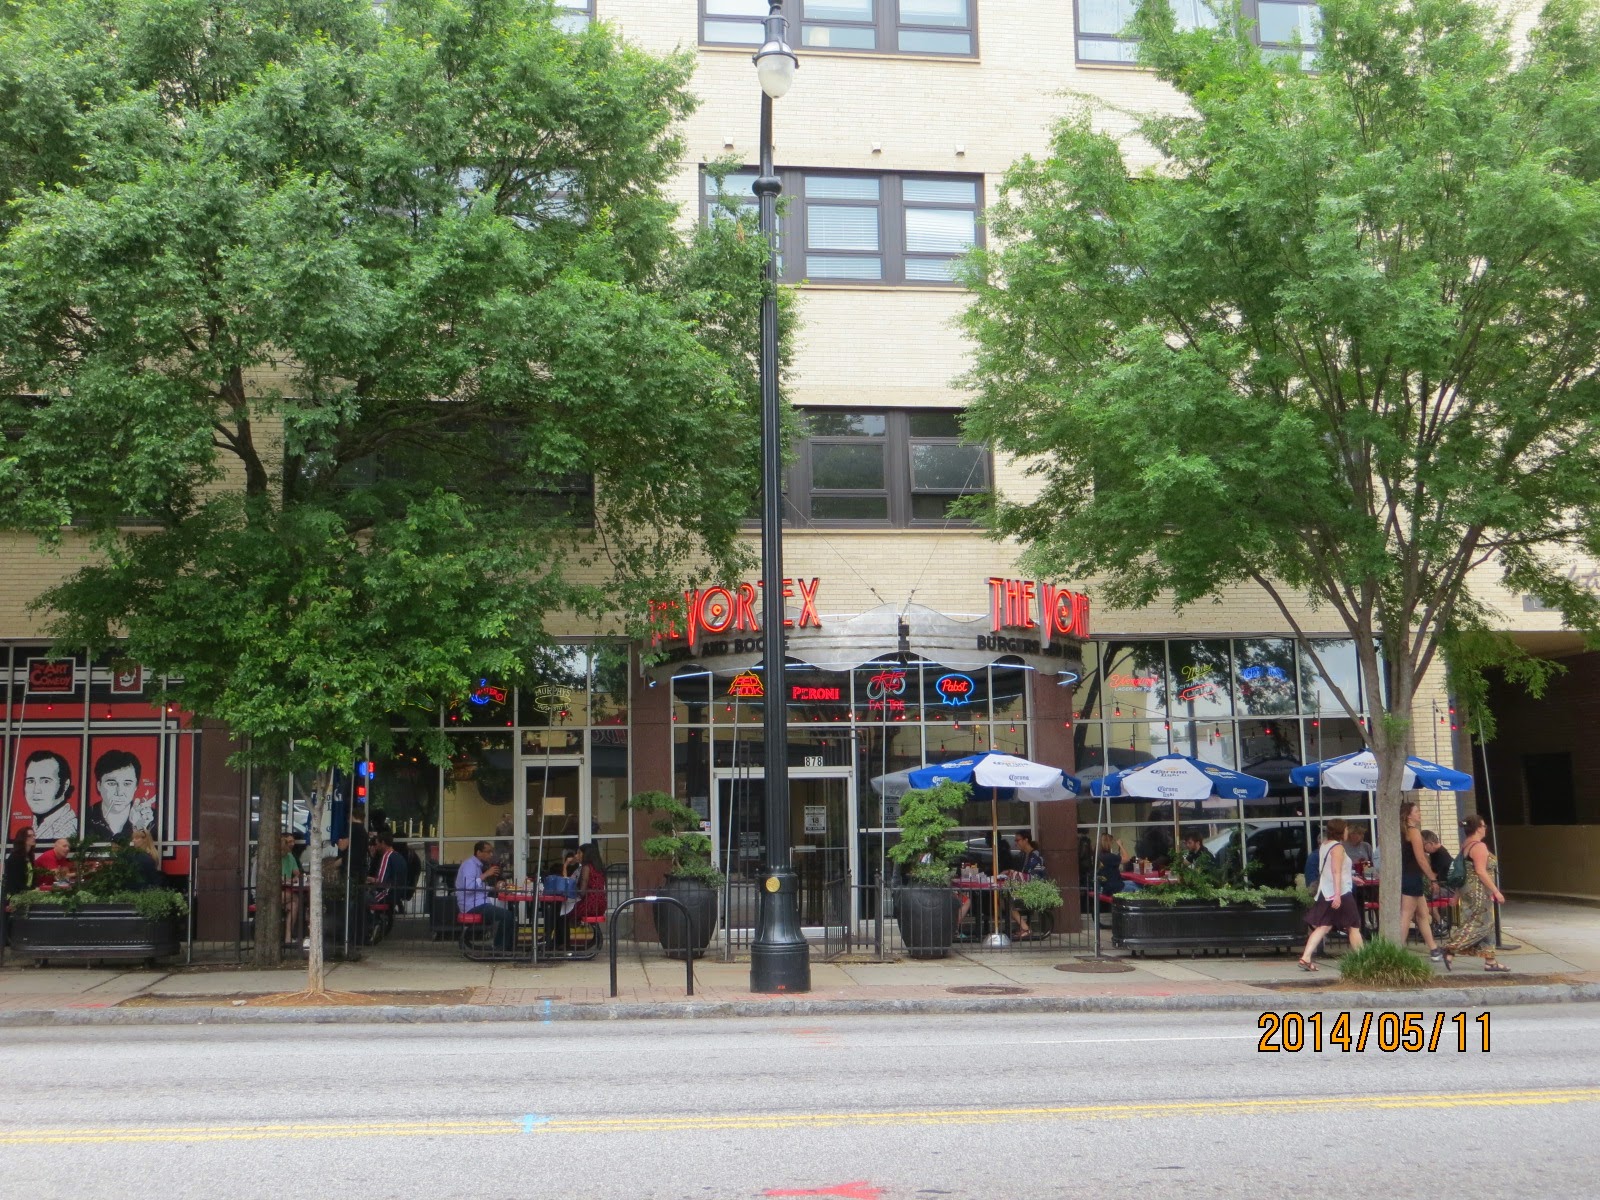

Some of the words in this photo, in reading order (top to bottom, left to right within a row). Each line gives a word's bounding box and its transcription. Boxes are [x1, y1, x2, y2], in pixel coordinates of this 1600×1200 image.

[684, 577, 822, 647] VOREX
[986, 577, 1036, 632] THE
[734, 635, 790, 654] BOOE
[792, 686, 840, 700] PERONI
[941, 678, 969, 692] Pabst
[805, 756, 823, 767] 878
